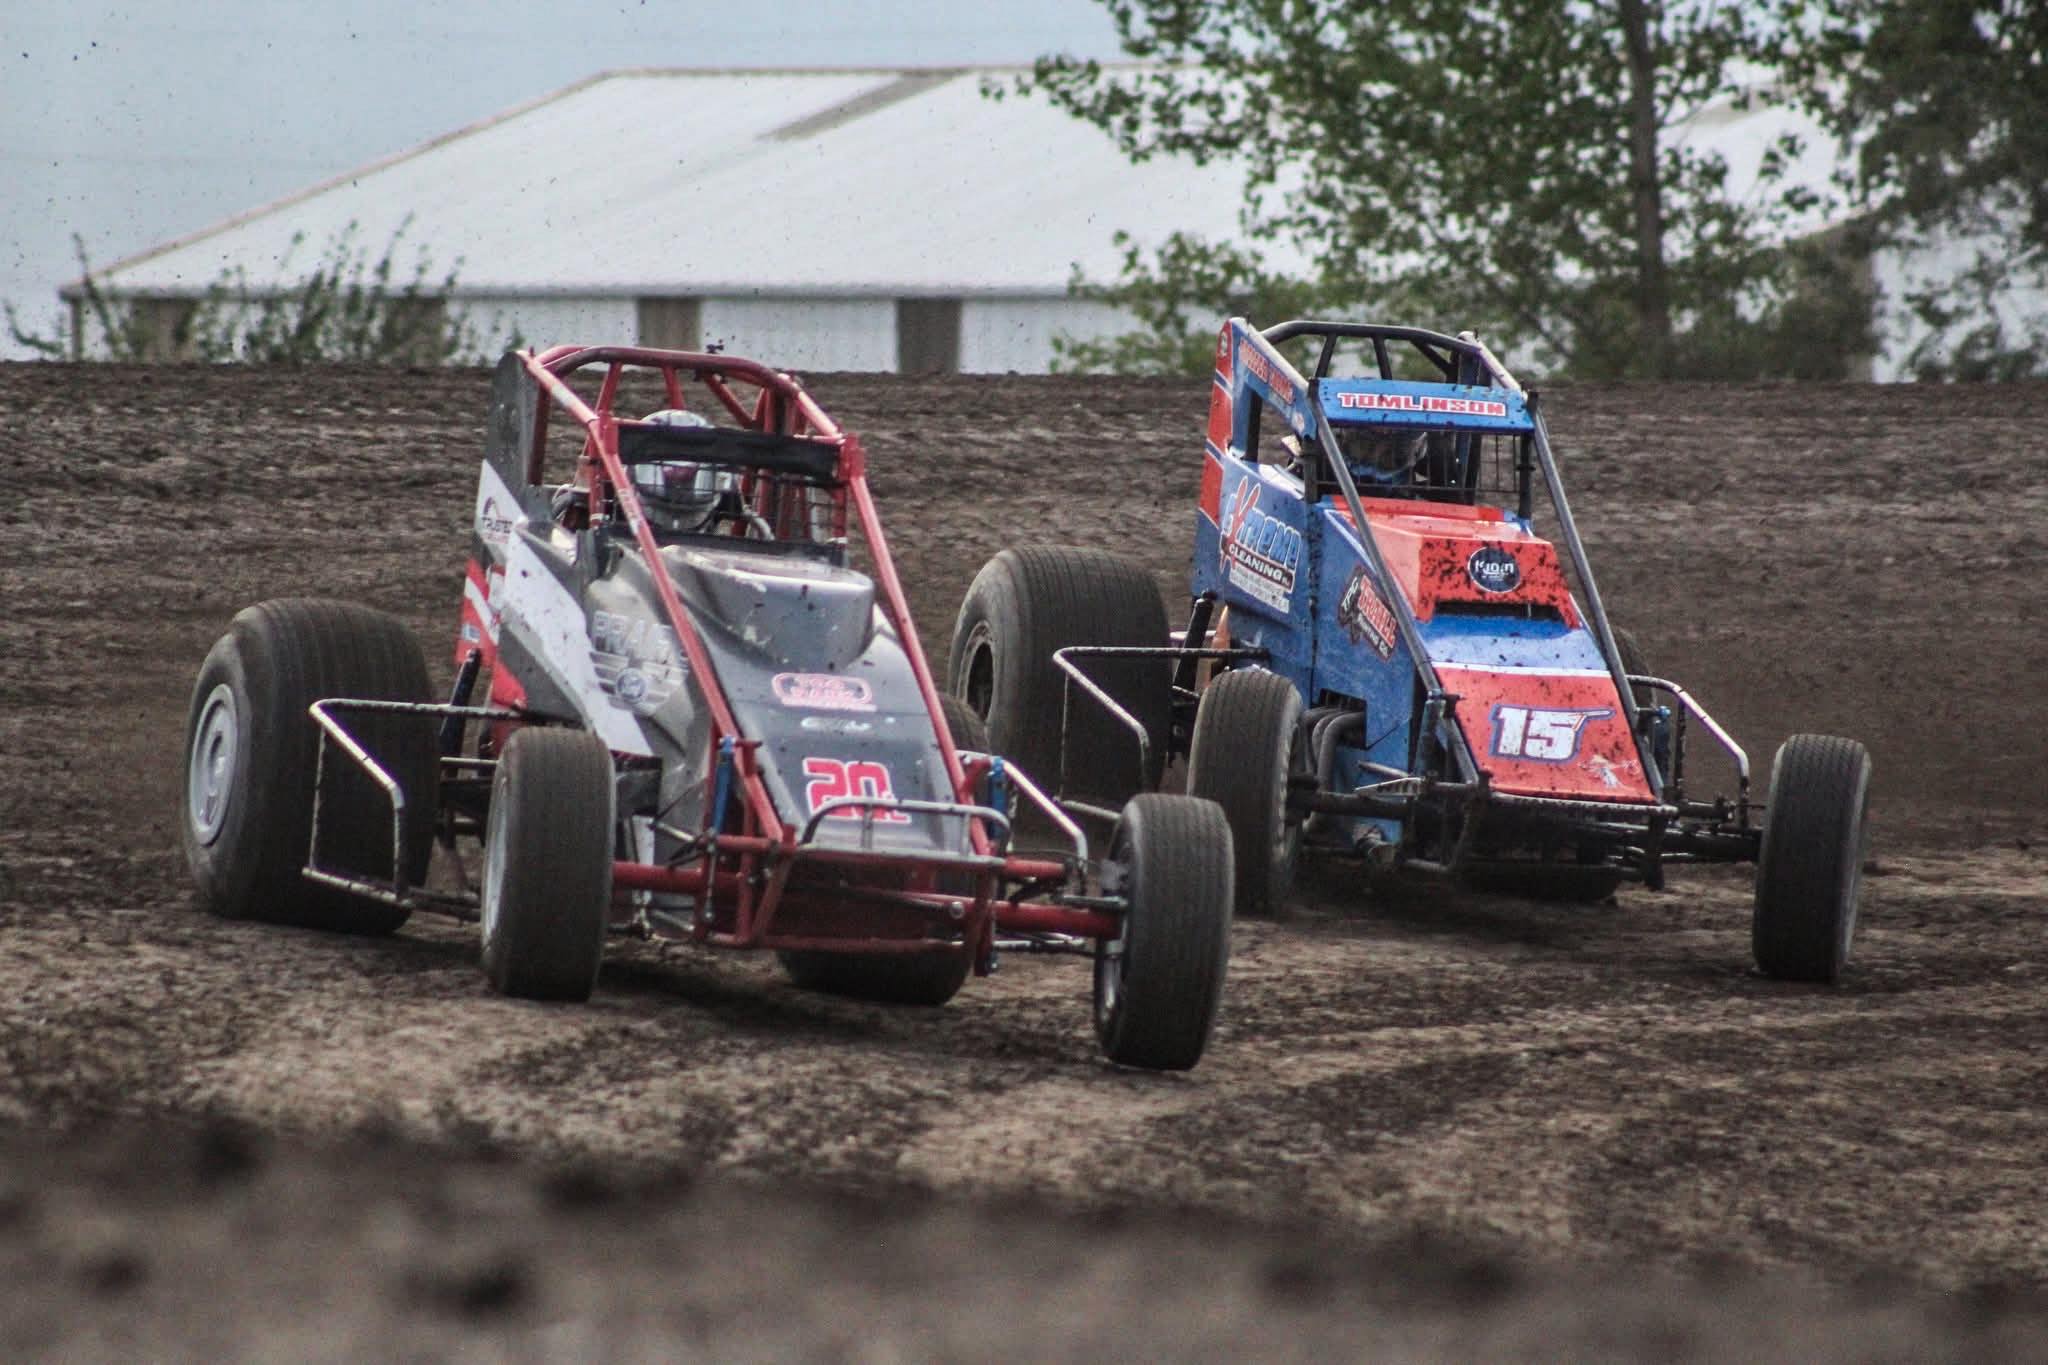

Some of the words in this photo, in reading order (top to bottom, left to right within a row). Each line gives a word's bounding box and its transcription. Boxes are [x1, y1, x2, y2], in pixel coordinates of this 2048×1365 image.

[1338, 393, 1507, 417] TOMLINSON
[1229, 543, 1284, 582] CLEANING
[1489, 703, 1614, 764] 15
[803, 757, 895, 822] 20
